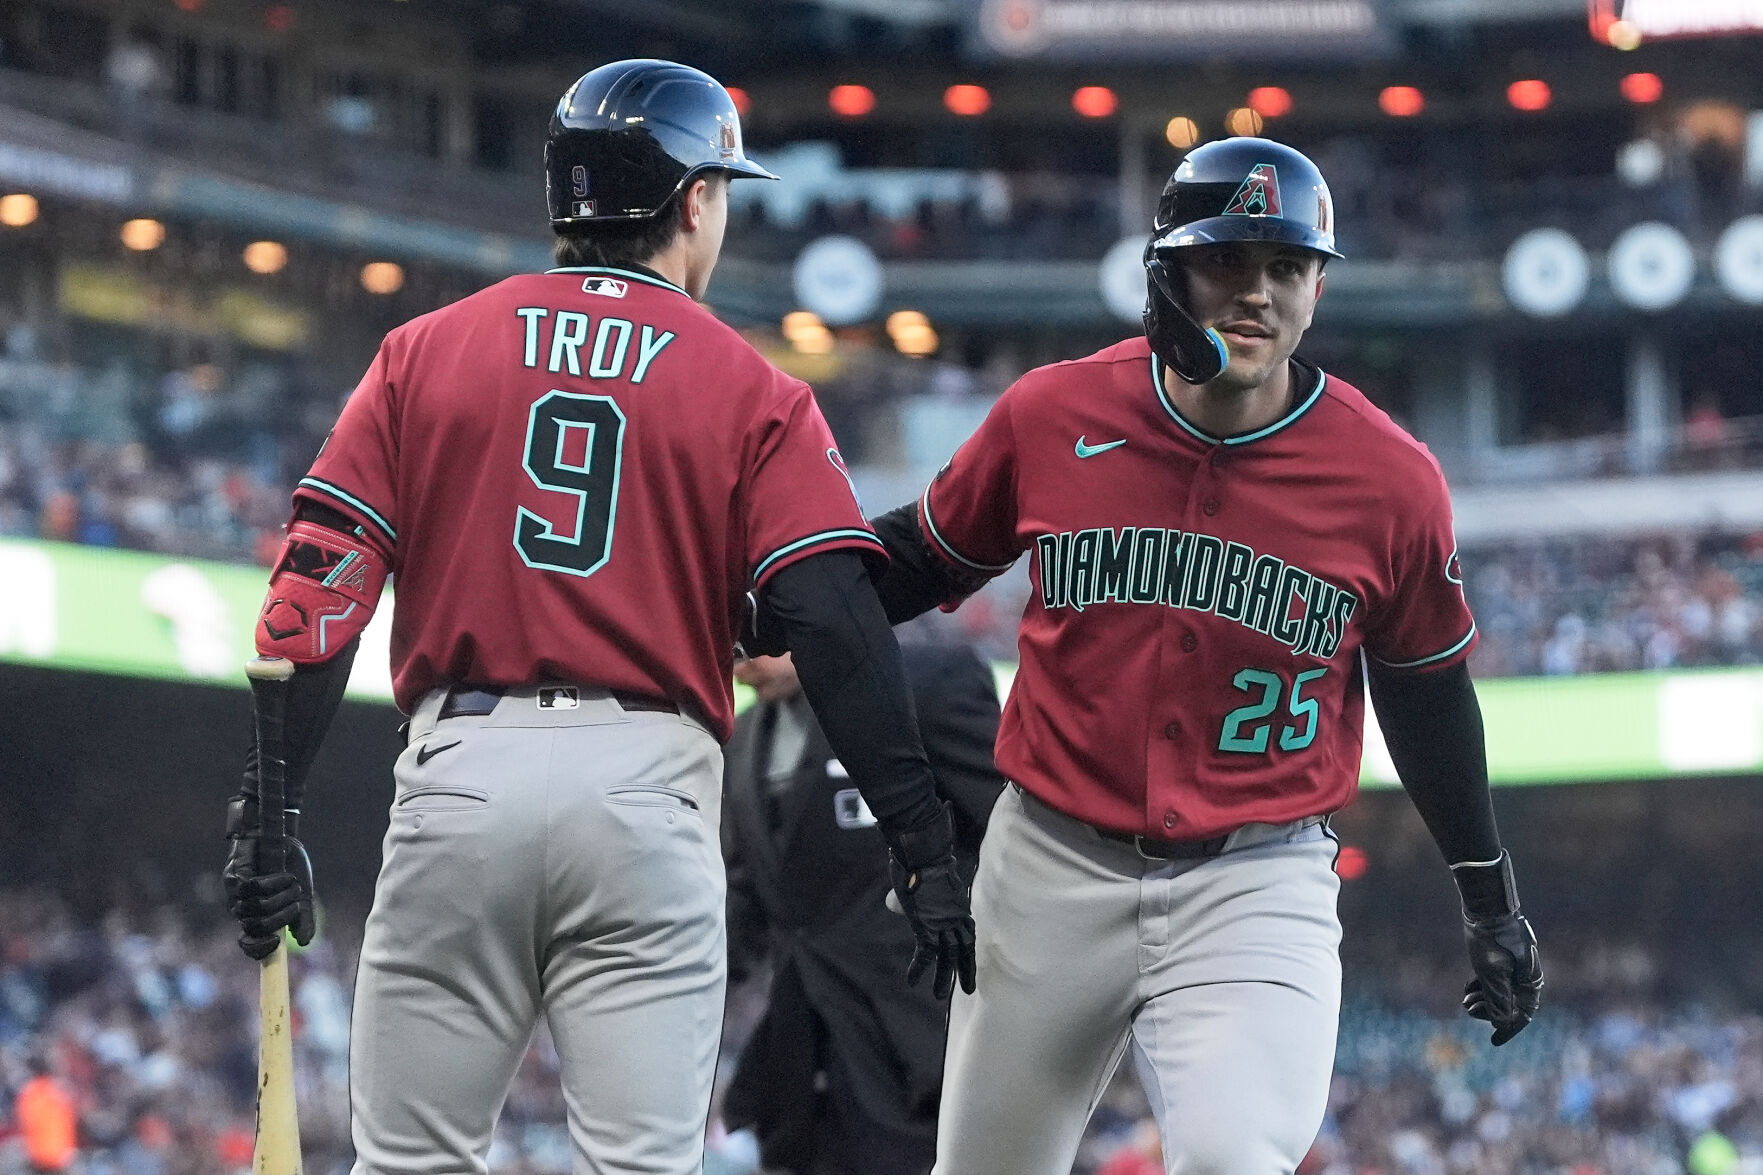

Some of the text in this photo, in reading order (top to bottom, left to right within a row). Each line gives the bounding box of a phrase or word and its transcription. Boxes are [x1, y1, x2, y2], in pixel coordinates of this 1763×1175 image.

[572, 165, 587, 197] 9
[516, 307, 676, 383] TROY
[512, 388, 626, 578] 9
[1037, 526, 1358, 660] DIAMONDBACKS
[1218, 667, 1328, 753] 25
